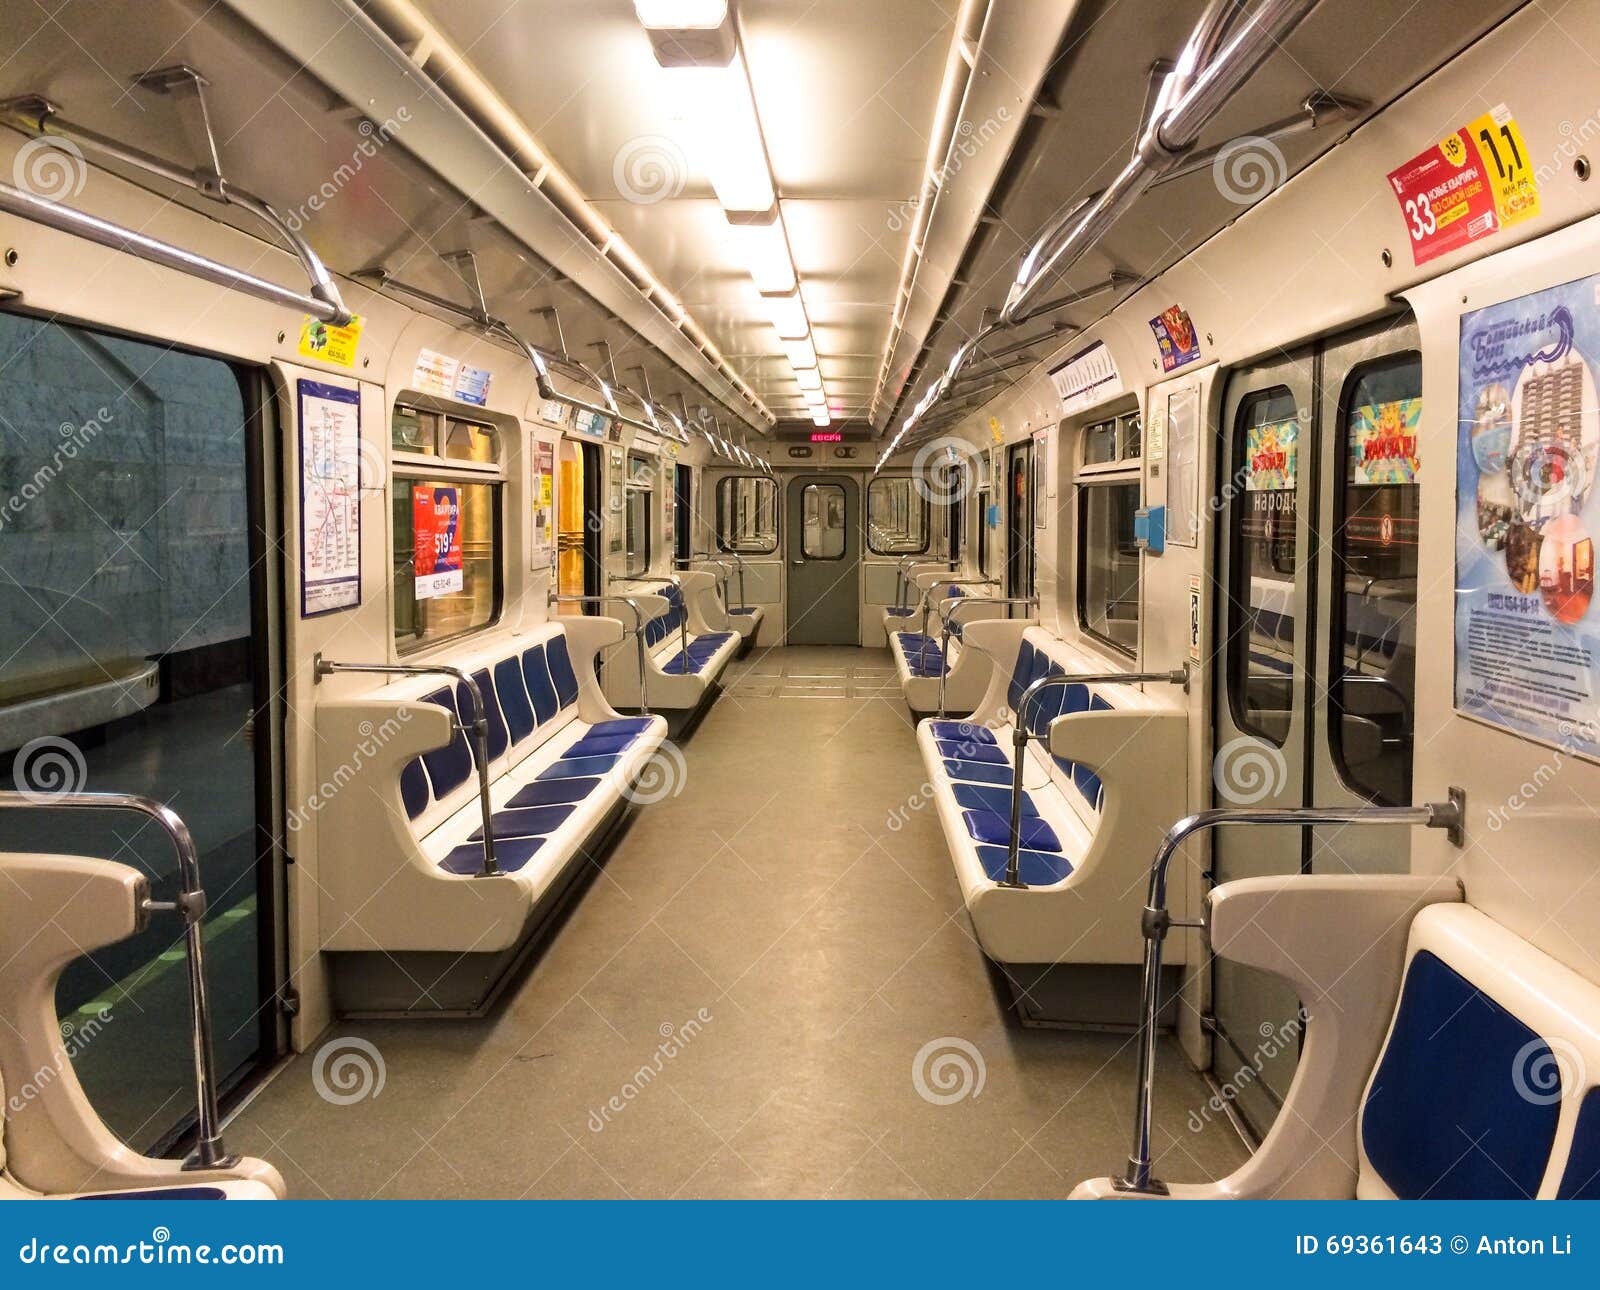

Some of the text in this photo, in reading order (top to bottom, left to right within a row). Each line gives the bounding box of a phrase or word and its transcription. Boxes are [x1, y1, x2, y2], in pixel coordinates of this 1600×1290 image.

[1479, 125, 1523, 182] 1,1
[1405, 192, 1437, 241] 33
[435, 533, 449, 554] 519
